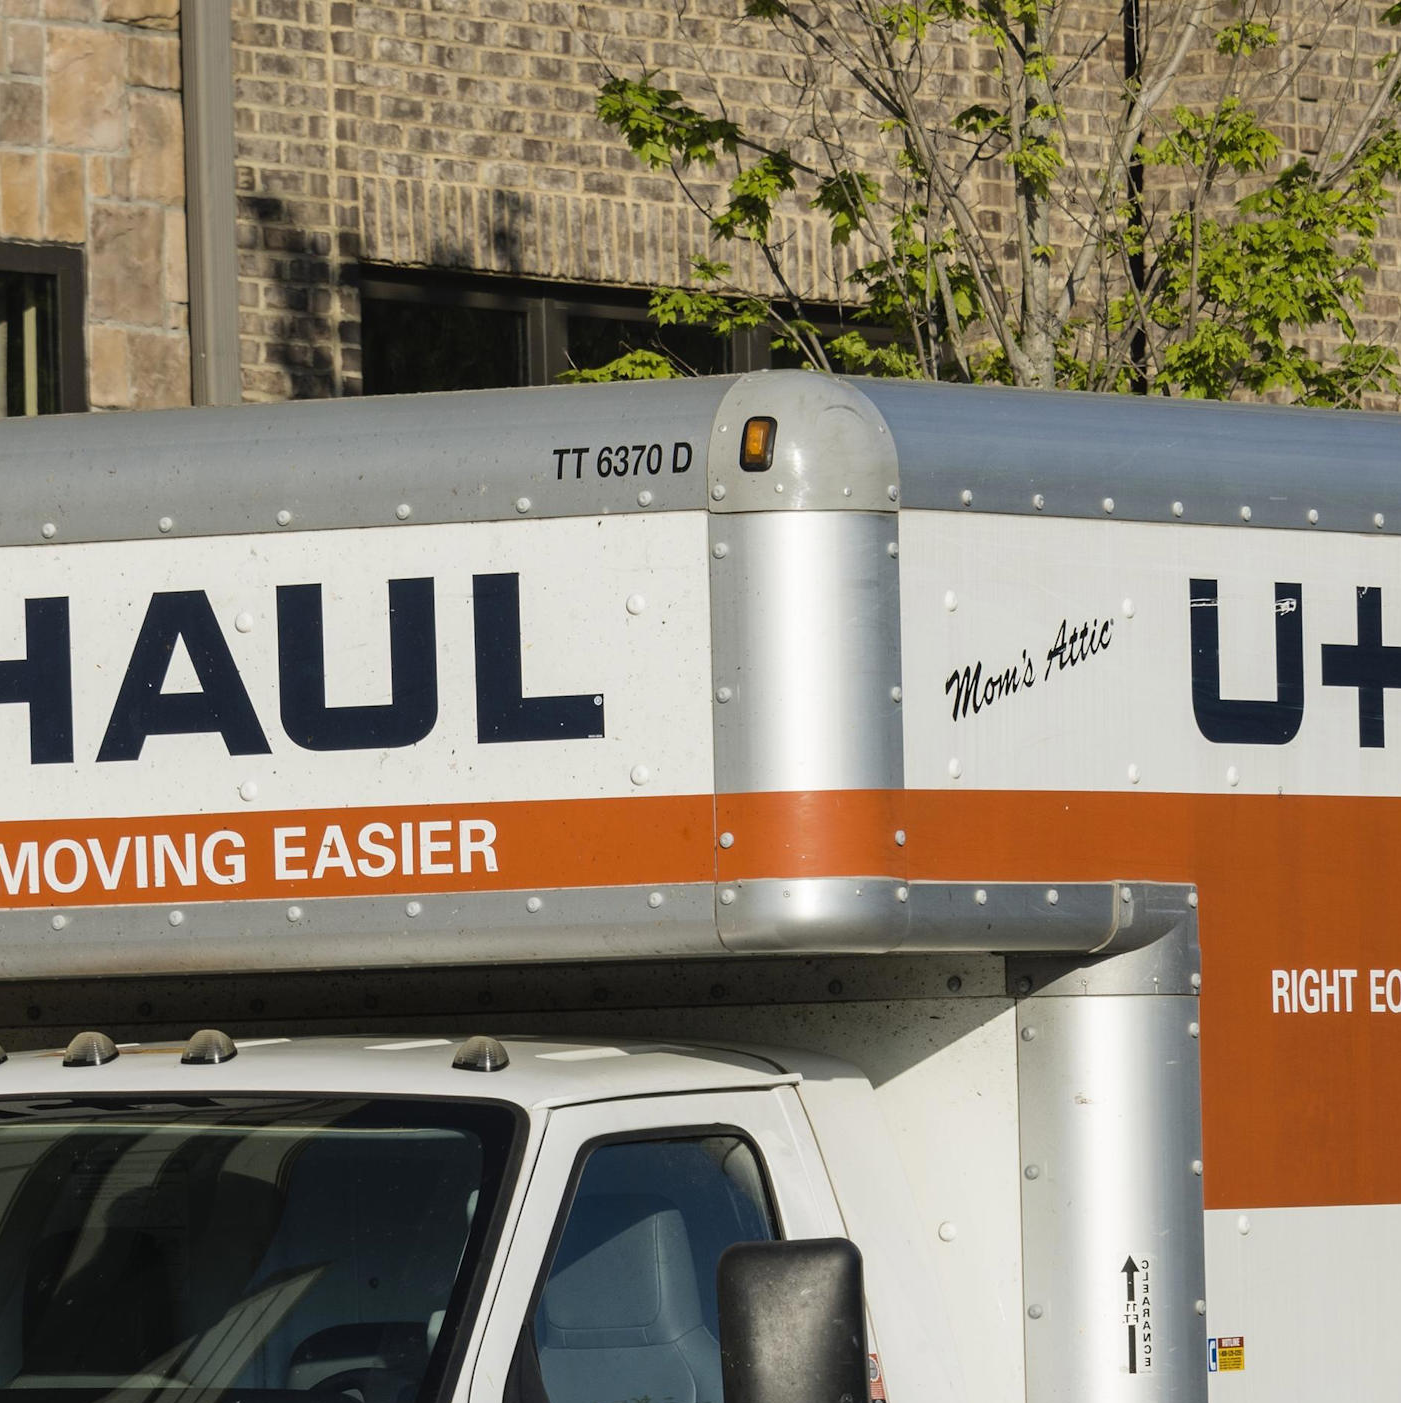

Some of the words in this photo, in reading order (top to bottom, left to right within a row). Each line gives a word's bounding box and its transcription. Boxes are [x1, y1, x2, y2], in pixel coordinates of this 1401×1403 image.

[552, 447, 590, 480] TT
[597, 443, 662, 478] 6370
[672, 441, 693, 473] D
[945, 649, 1037, 722] Mom's
[273, 816, 500, 880] EASIER
[1271, 968, 1358, 1014] RIGHT
